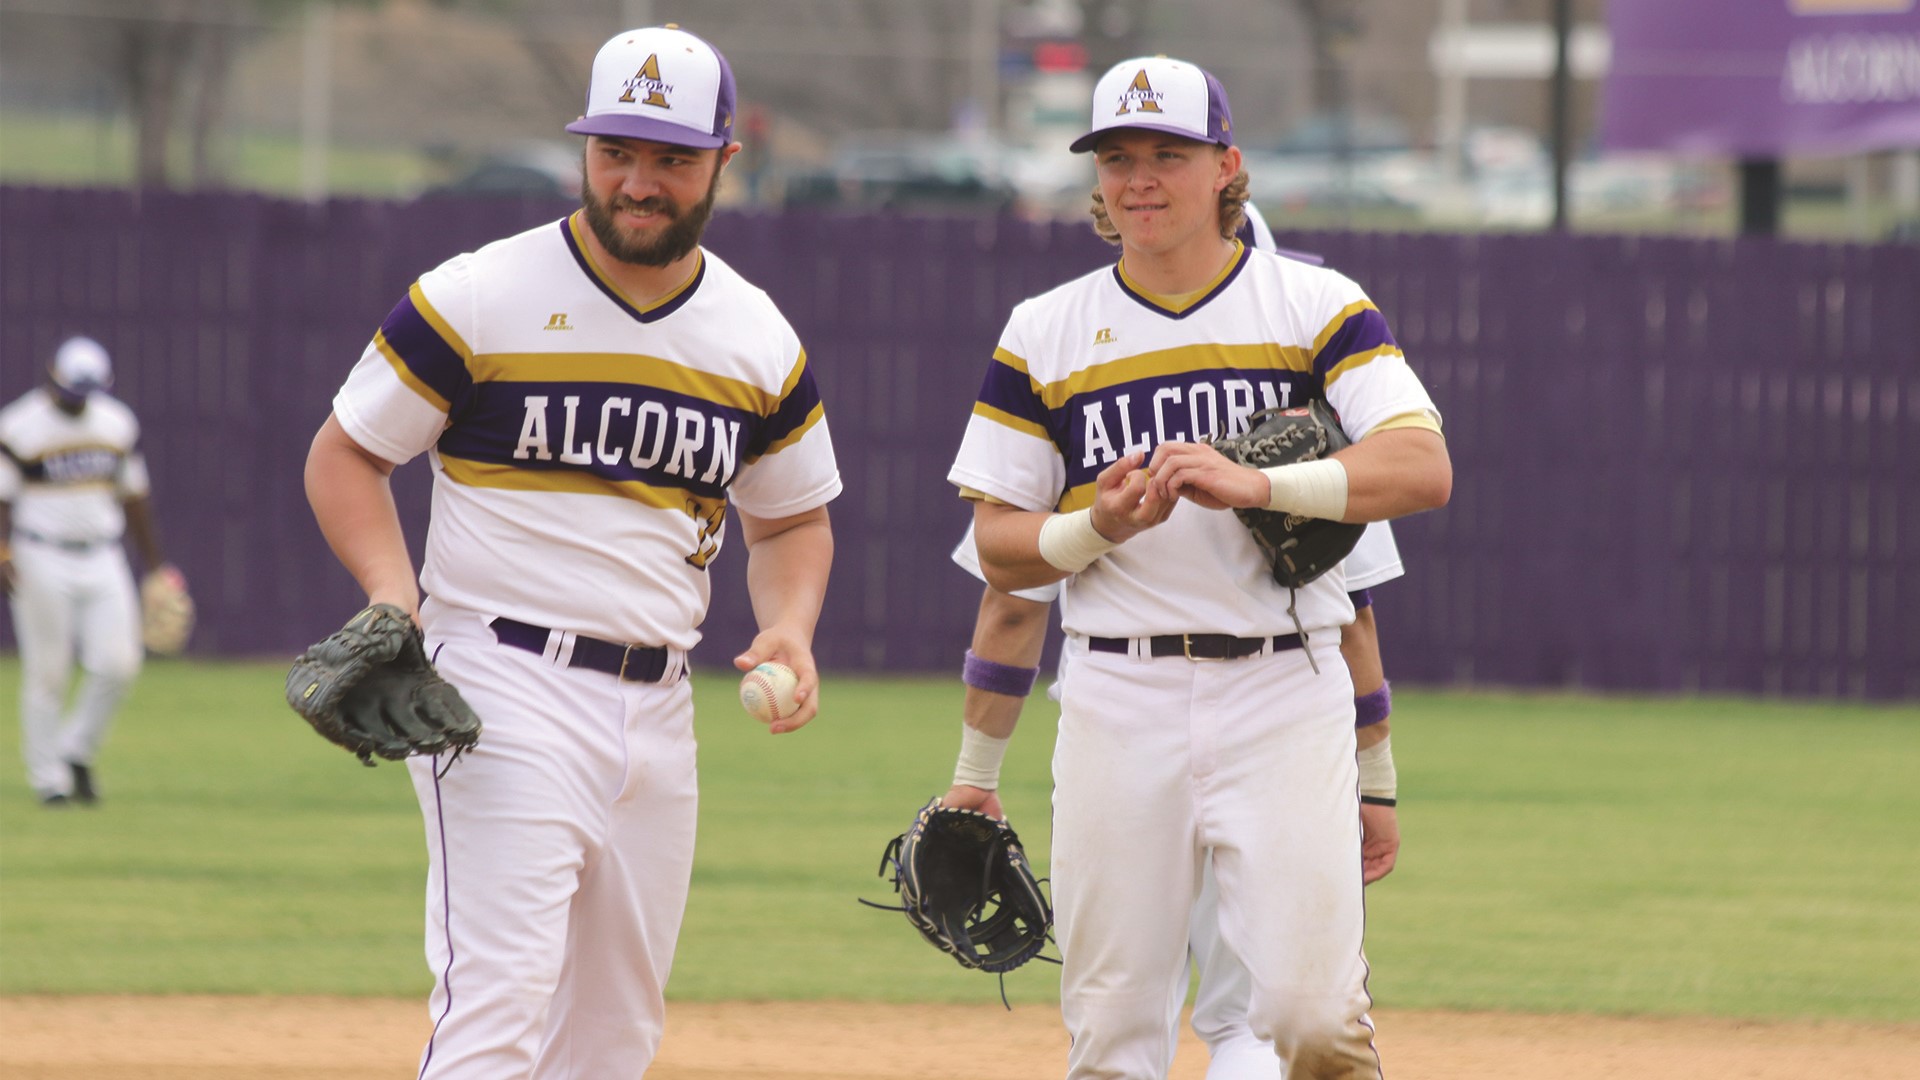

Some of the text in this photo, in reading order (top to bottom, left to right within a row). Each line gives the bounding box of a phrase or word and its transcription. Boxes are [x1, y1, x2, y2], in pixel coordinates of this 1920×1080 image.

[622, 78, 673, 94] ALCORN
[1117, 91, 1164, 102] ALCORN
[513, 396, 740, 487] ALCORN
